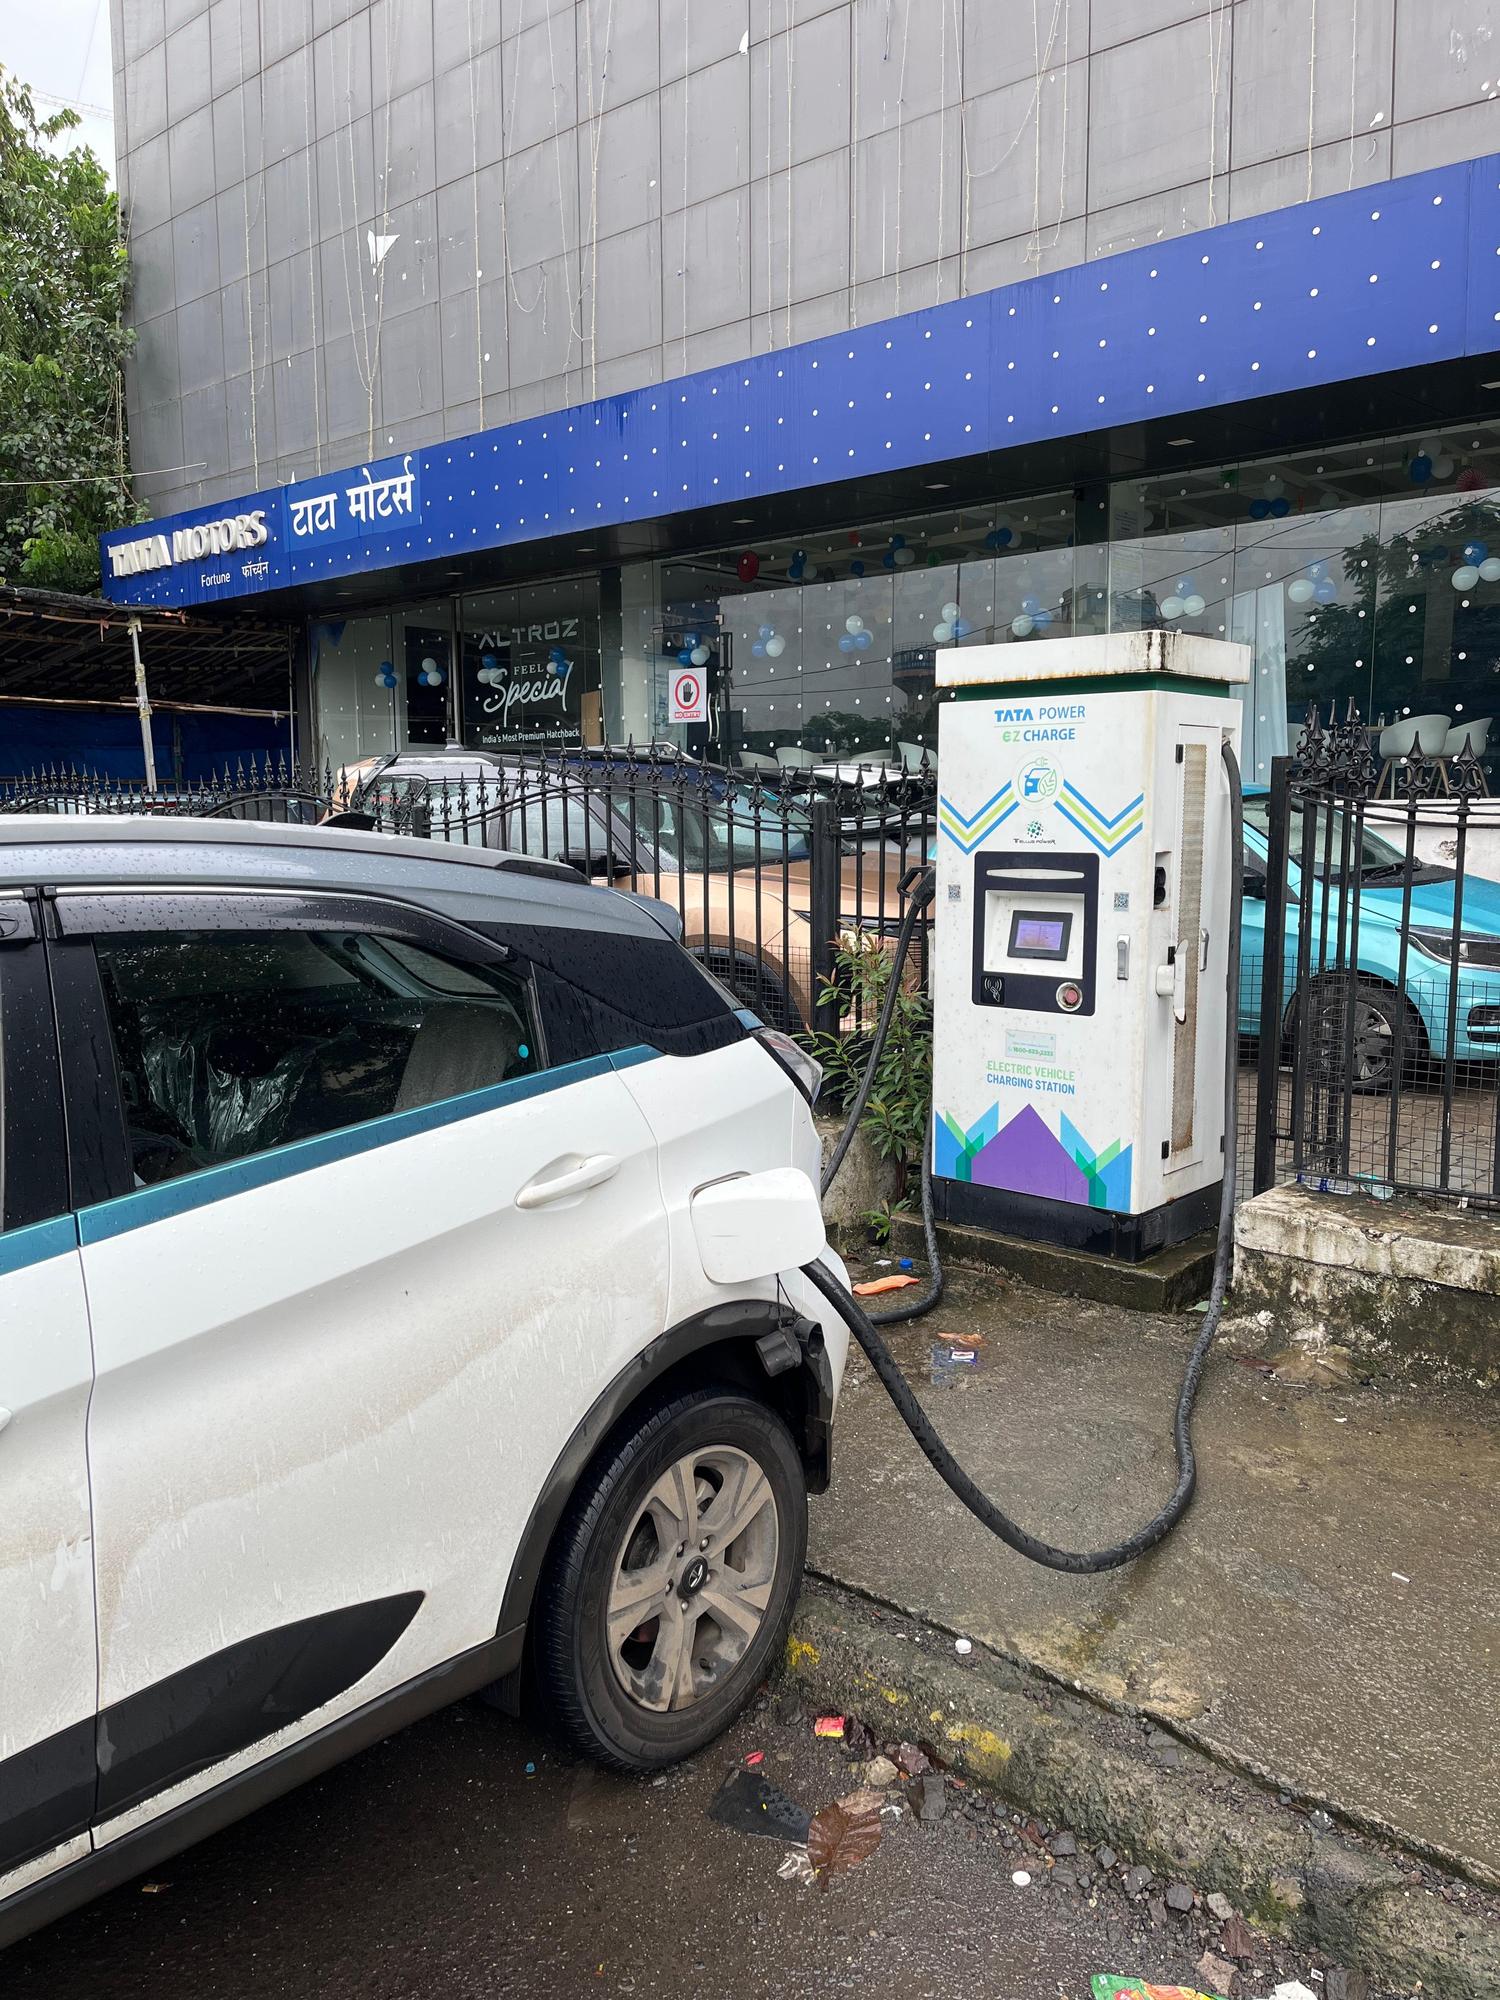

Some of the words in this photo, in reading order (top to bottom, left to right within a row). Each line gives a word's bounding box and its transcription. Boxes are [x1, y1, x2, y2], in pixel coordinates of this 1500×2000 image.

[289, 492, 339, 537] टाटा
[345, 455, 416, 523] मोटर्स
[108, 535, 172, 577] TATA
[172, 510, 267, 563] MOTORS
[200, 572, 231, 588] Fortune
[478, 618, 577, 650] ALTROZ
[513, 663, 545, 676] FEEL
[482, 661, 575, 728] Special
[994, 708, 1034, 722] TATA
[1039, 705, 1086, 720] POWER
[482, 733, 502, 744] India's
[502, 732, 518, 743] Most
[518, 731, 546, 741] Premium
[546, 727, 580, 740] Hatchback
[1023, 727, 1076, 742] CHARGE
[987, 1060, 1032, 1076] ELECTRIC
[1034, 1066, 1075, 1081] VEHICLE
[987, 1074, 1033, 1089] CHARGING
[1035, 1081, 1075, 1094] STATION
